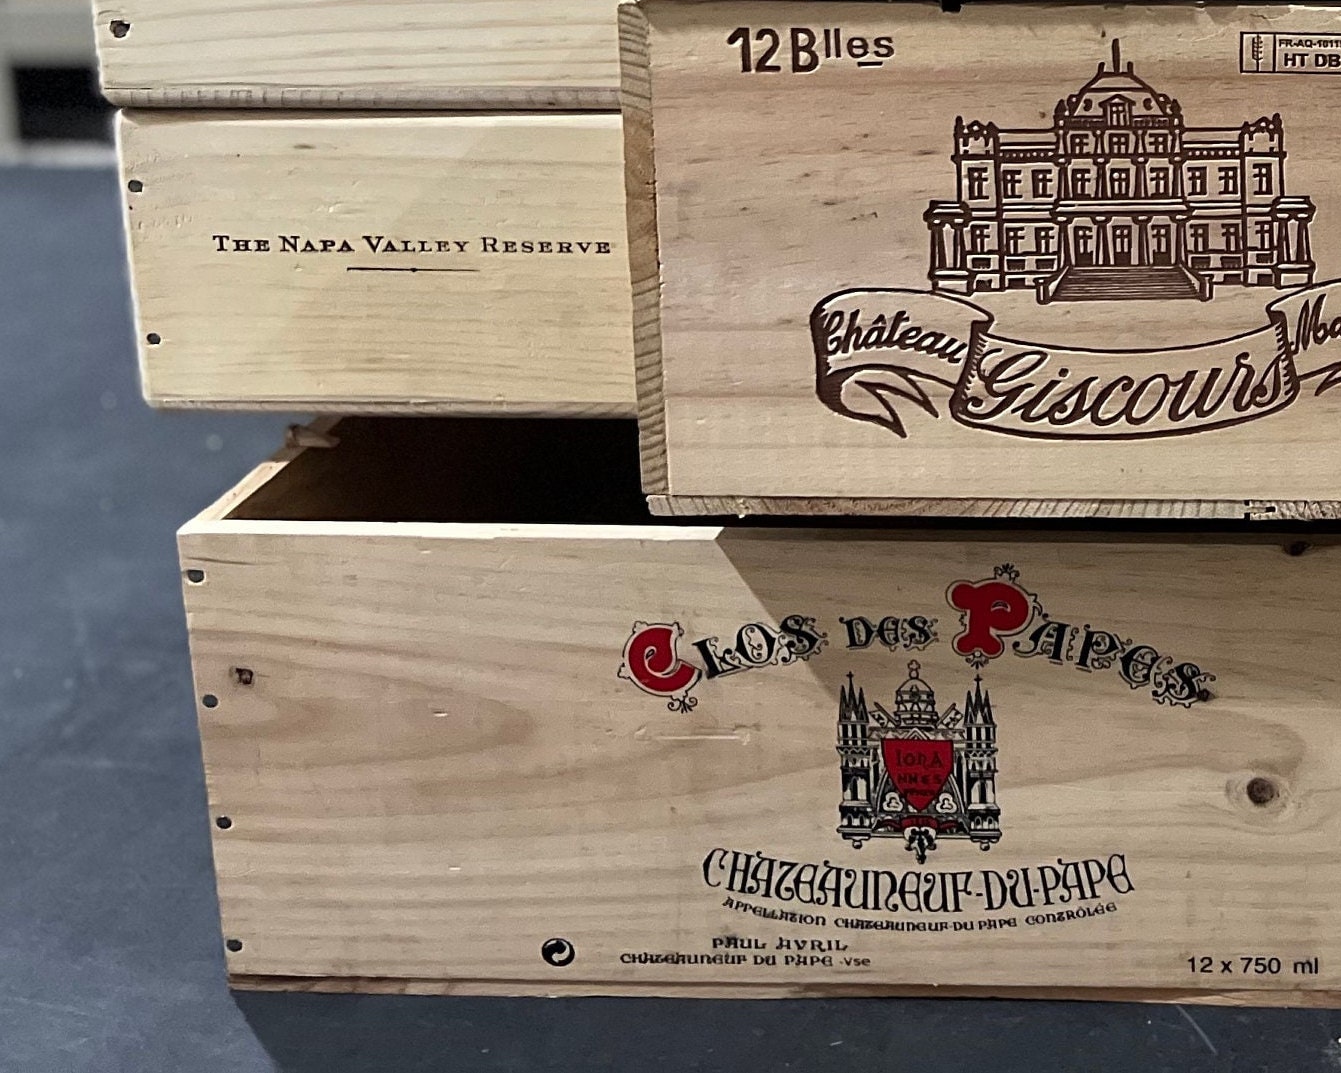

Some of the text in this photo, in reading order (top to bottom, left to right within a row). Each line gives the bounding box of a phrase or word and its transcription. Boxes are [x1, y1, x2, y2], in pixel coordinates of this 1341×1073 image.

[1283, 52, 1341, 68] HT DB
[212, 235, 611, 254] THE NAPA VALLEY RESERVE
[965, 348, 1291, 429] Giscours
[617, 614, 829, 713] CLOS
[712, 936, 848, 951] PAUL AVRIL
[753, 954, 776, 966] DU
[784, 954, 833, 967] PAPE
[1187, 956, 1319, 974] 12 x 750 ml
